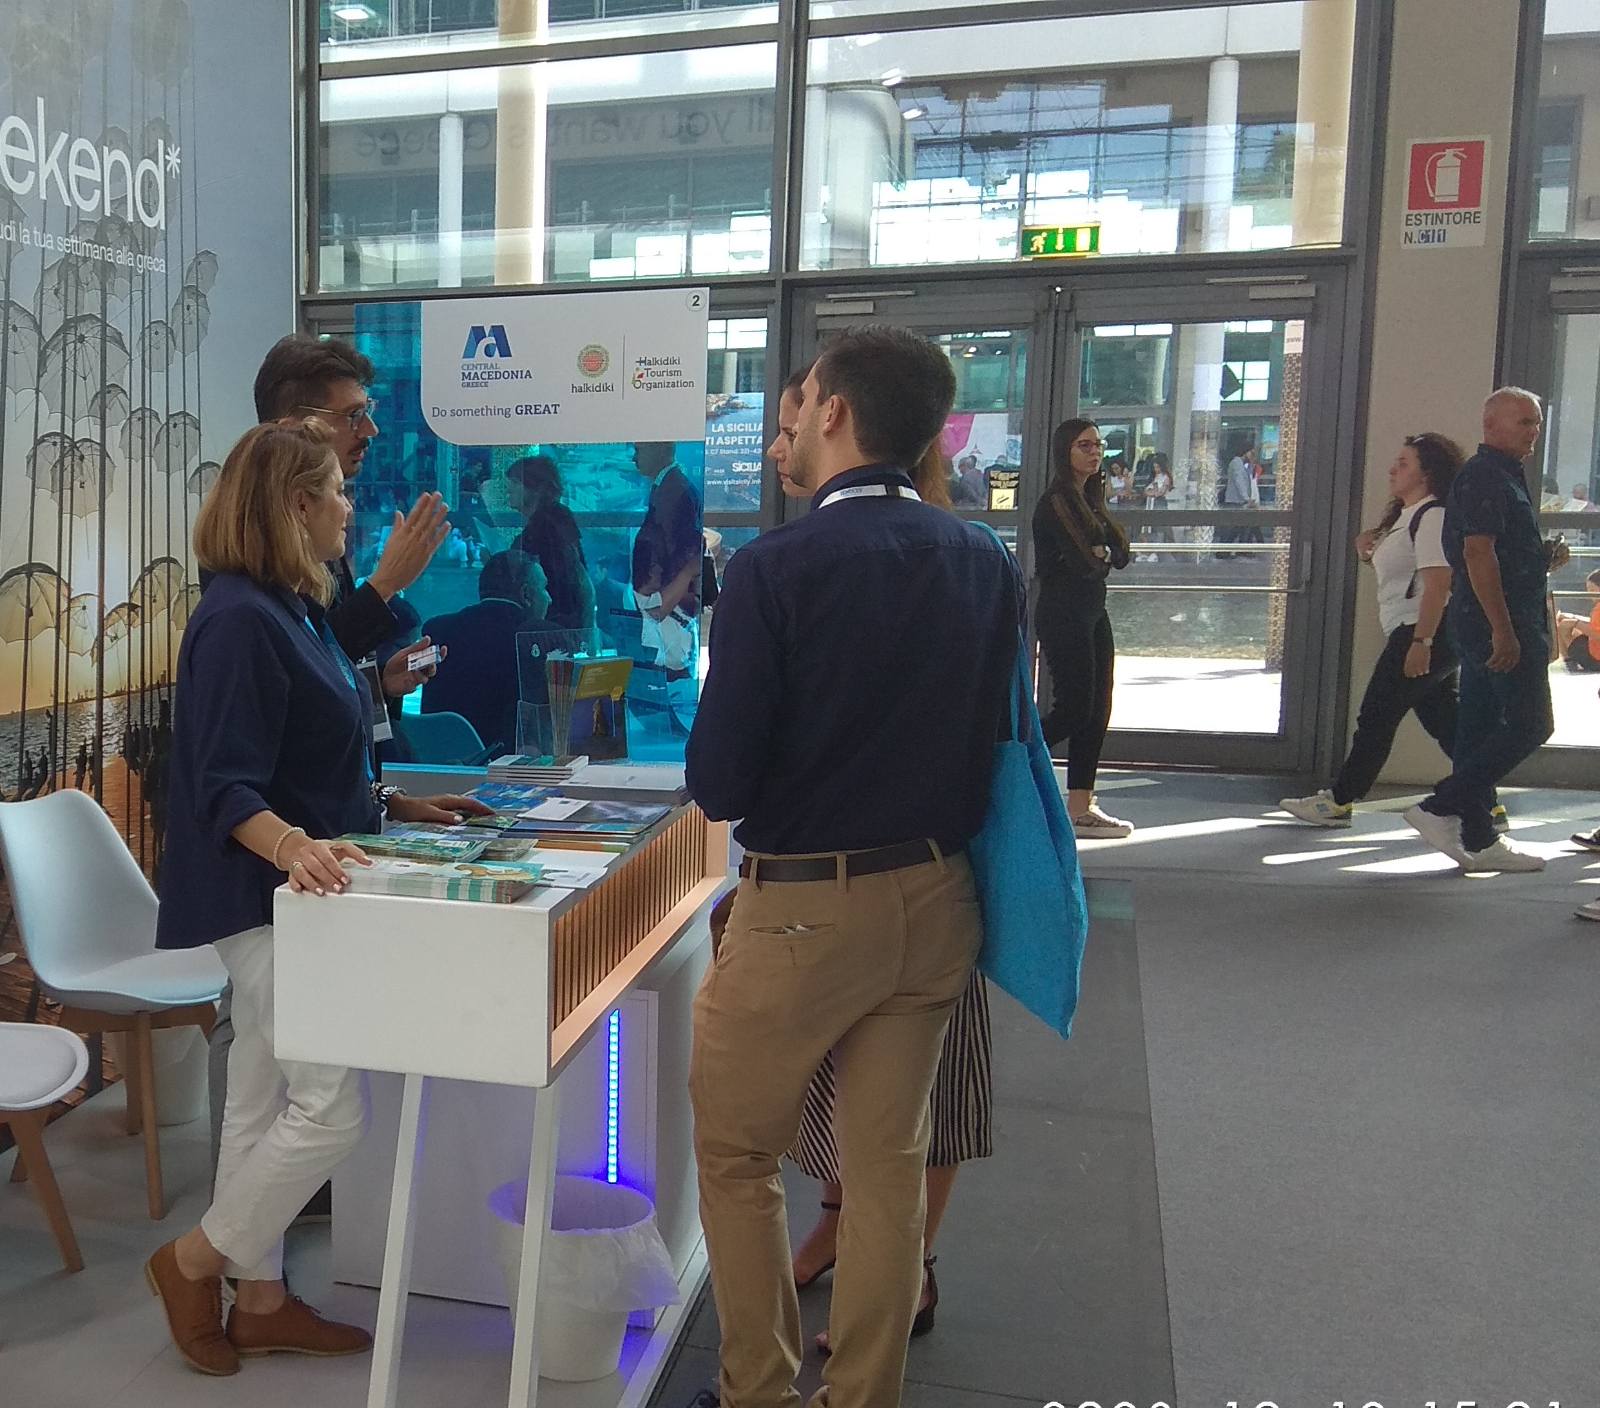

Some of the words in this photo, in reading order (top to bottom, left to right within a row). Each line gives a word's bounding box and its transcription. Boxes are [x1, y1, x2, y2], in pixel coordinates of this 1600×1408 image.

[1405, 211, 1481, 226] ESTINTORE
[19, 222, 30, 245] la
[33, 226, 54, 250] tua
[57, 234, 115, 262] settimana
[116, 245, 134, 266] alla
[137, 253, 165, 273] greca
[692, 294, 700, 307] 2
[636, 356, 681, 366] Halkidiki
[461, 363, 500, 371] CENTRAL
[461, 370, 532, 381] MACEDONIA
[644, 368, 682, 378] Tourism
[571, 382, 614, 394] halkidiki
[633, 379, 695, 391] Organization
[432, 406, 447, 417] Do
[450, 405, 511, 418] something
[515, 404, 560, 415] GREAT
[711, 423, 724, 433] LA
[727, 422, 763, 433] SICILIA
[716, 435, 763, 446] ASPETTA
